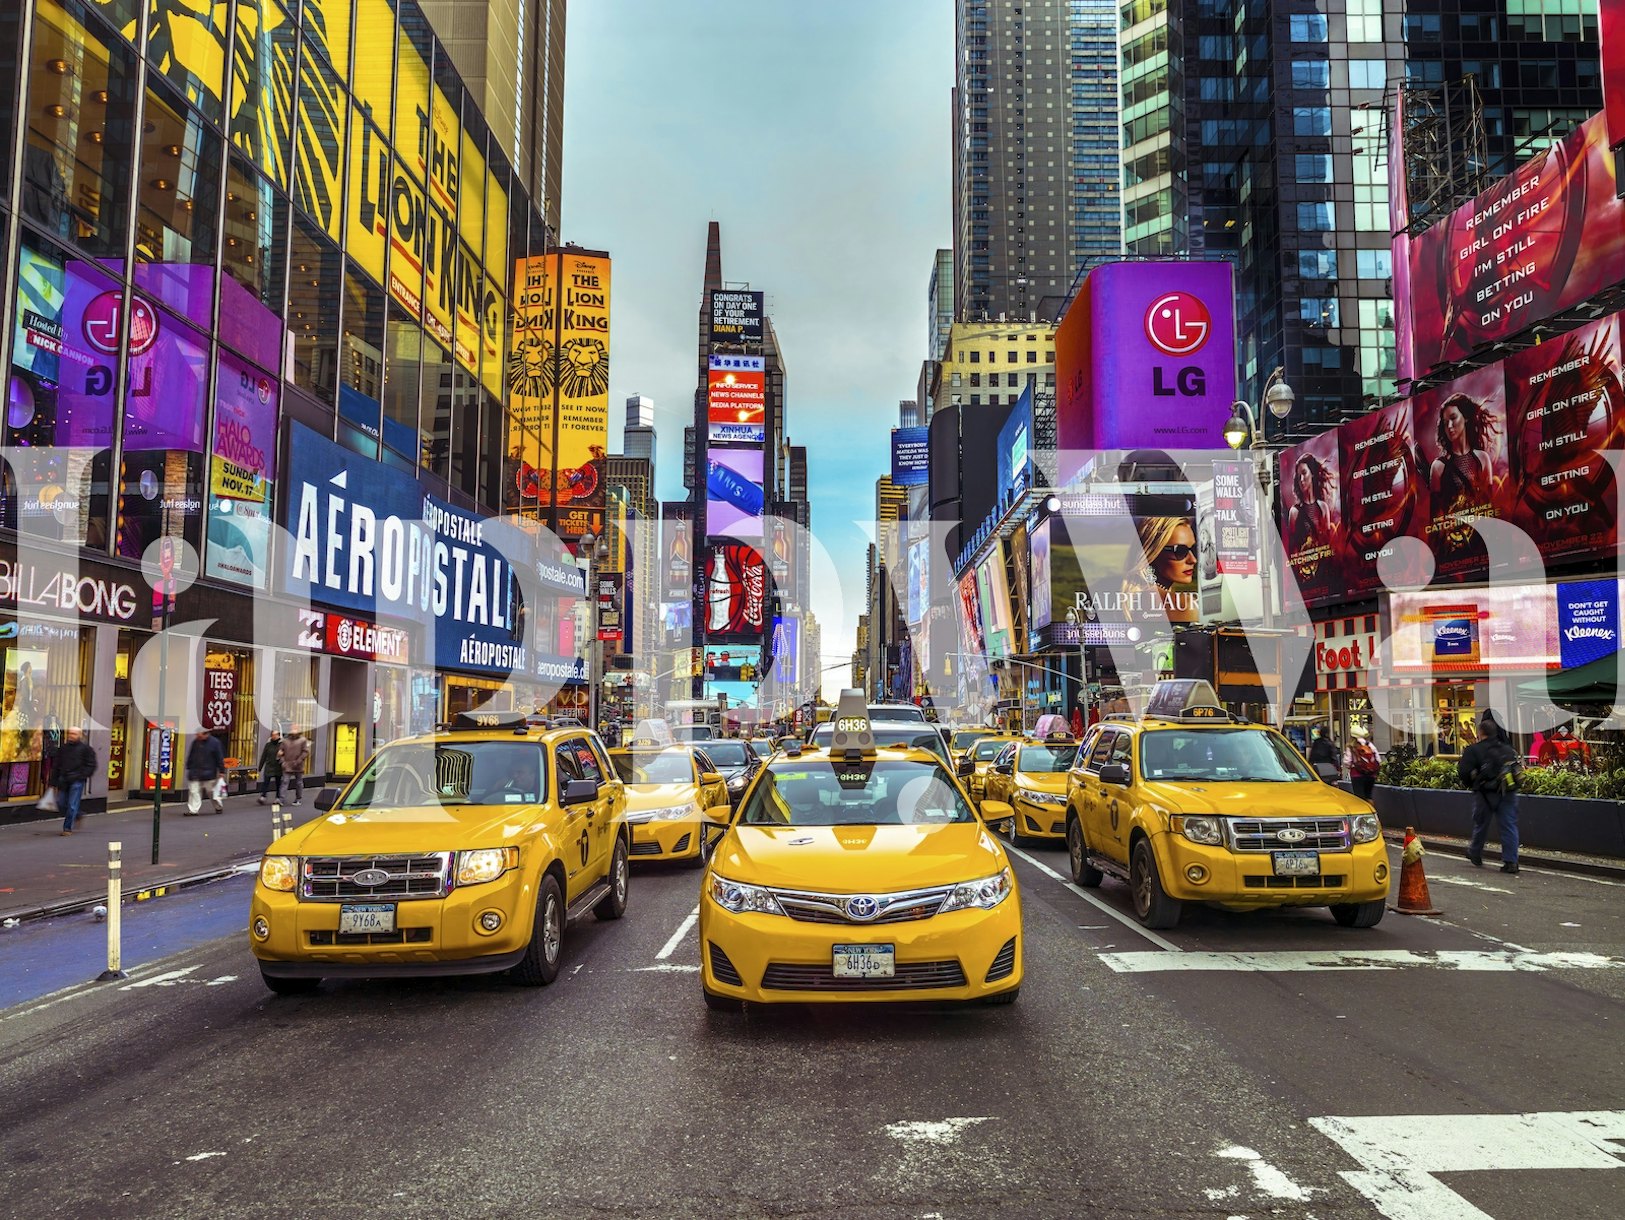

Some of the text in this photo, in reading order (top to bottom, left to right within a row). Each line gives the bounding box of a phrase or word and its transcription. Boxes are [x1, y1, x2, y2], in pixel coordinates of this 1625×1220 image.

[416, 103, 456, 201] THE
[1465, 175, 1541, 231] REMEMBER
[359, 100, 498, 346] LION KING
[1460, 197, 1549, 260] GIRL ON FIRE
[1474, 236, 1536, 277] I'M STILL
[571, 274, 599, 287] THE
[1476, 261, 1536, 302] BETTING
[391, 277, 420, 313] ENTRANCE
[567, 288, 604, 306] LION
[714, 293, 752, 302] CONGRATS
[725, 310, 745, 318] YOUR
[726, 302, 740, 310] DAY
[1481, 290, 1534, 326] ON YOU
[29, 315, 57, 334] Hosted
[564, 309, 608, 330] KING
[713, 325, 745, 333] DIANA P.
[33, 335, 95, 366] NICK CANNON
[1530, 356, 1590, 385] REMEMBER
[1153, 366, 1206, 397] LG
[1526, 389, 1596, 421] GIRL ON FIRE
[563, 415, 603, 424] REMEMBER
[218, 414, 251, 444] HALO
[720, 426, 753, 434] XINHUA
[1354, 430, 1394, 451] REMEMBER
[1539, 430, 1587, 451] I'M STILL
[216, 433, 265, 470] AWARDS
[222, 462, 256, 482] SUNDA
[1353, 459, 1399, 480] GIRL ON FIRE
[1541, 465, 1590, 486] BETTING
[1215, 475, 1239, 486] SOME
[1216, 487, 1243, 498] WALLS
[1372, 490, 1393, 502] STILL
[1063, 498, 1121, 511] sunglass hut
[1470, 503, 1492, 514] GAMES
[1546, 502, 1589, 520] ON YOU
[559, 519, 588, 527] TICKETS
[569, 511, 589, 520] GET
[1216, 510, 1237, 521] TALK
[1425, 506, 1501, 534] CATCHING FIRE
[1362, 518, 1394, 533] BETTING
[1286, 553, 1319, 568] CATCHING
[1365, 548, 1394, 561] ON YOU
[0, 560, 137, 620] BILLABONG
[1075, 591, 1142, 611] RALPH
[1568, 601, 1593, 609] DON'T
[1573, 608, 1604, 617] CAUGHT
[352, 622, 401, 657] ELEMENT
[1436, 626, 1468, 636] Kleenex
[1564, 625, 1612, 641] Kleenex
[460, 633, 525, 670] AÉROPOSTALE
[1316, 640, 1362, 671] Foot
[209, 671, 233, 689] TEES
[214, 690, 228, 700] 3 for
[208, 701, 232, 726] $33
[476, 714, 500, 726] 9Y68
[1193, 708, 1214, 717] 6P76
[838, 719, 867, 731] 6H36
[353, 913, 381, 928] 9Y68A
